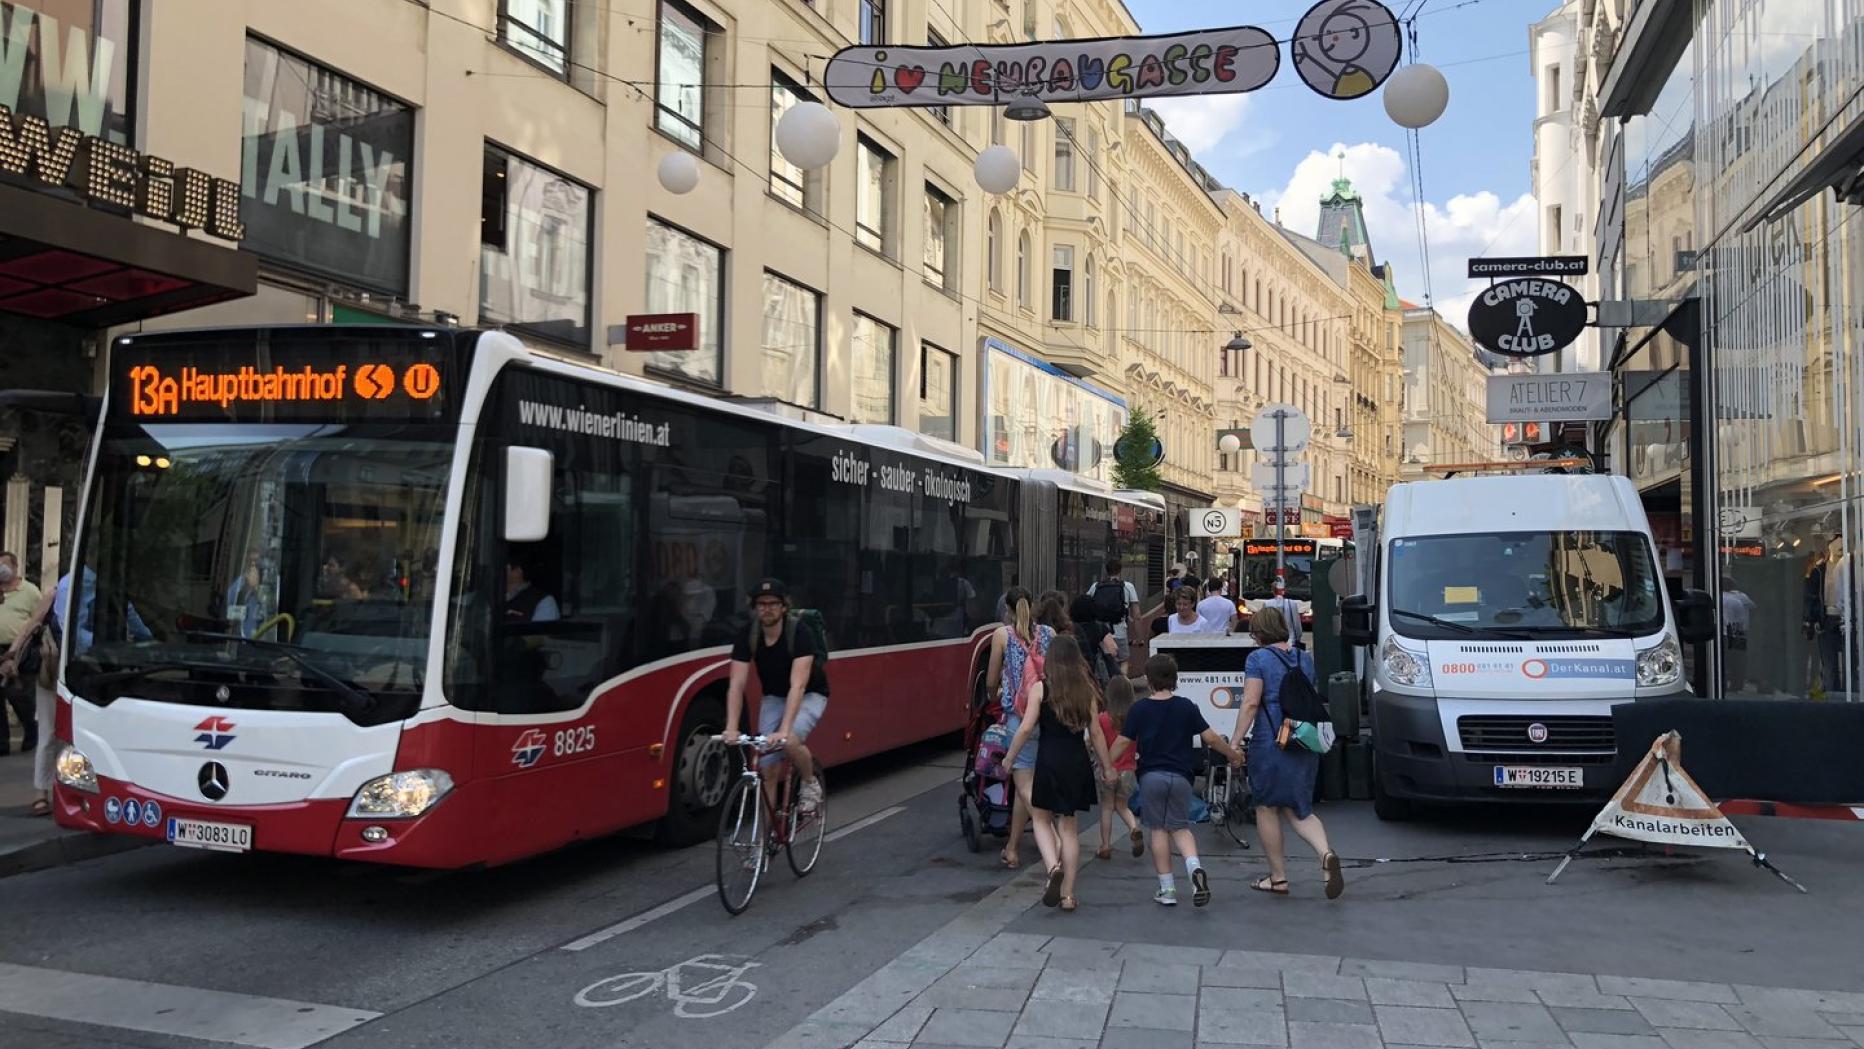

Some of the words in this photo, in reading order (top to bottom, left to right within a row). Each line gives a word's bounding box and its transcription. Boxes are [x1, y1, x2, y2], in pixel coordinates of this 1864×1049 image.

[1472, 260, 1585, 272] camera-club.at
[1483, 281, 1571, 306] CAMERA
[642, 322, 677, 333] ANKER
[1498, 334, 1555, 352] CLUB
[129, 365, 179, 415] 13A
[181, 364, 347, 407] Hauptbahnhof
[1510, 381, 1571, 404] ATELIER
[1575, 381, 1587, 402] 7
[519, 400, 670, 447] www.wienerlinien.at
[831, 449, 870, 486] sicher
[880, 461, 916, 493] sauber
[924, 467, 971, 507] ökologisch
[1442, 662, 1475, 674] 0800
[1551, 662, 1627, 674] DerKanal.at
[1222, 676, 1231, 684] 41
[554, 725, 596, 756] 8825
[254, 769, 312, 780] CITARO
[1507, 769, 1517, 781] W
[1528, 770, 1566, 783] 19215
[1569, 771, 1577, 783] E
[177, 822, 188, 838] W
[196, 824, 229, 843] 3083
[1614, 815, 1736, 837] Kanalarbeiten
